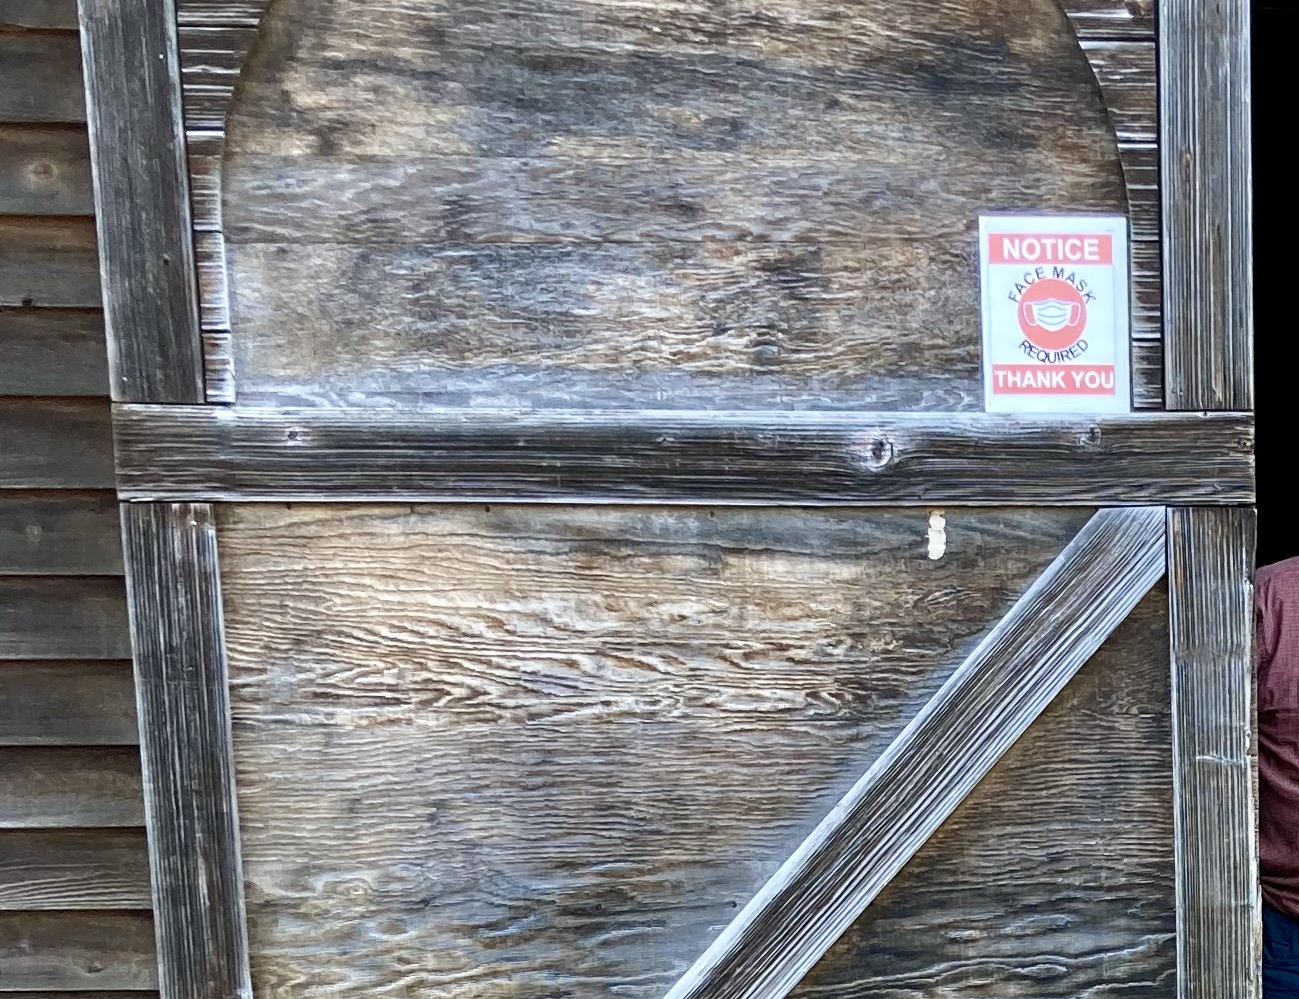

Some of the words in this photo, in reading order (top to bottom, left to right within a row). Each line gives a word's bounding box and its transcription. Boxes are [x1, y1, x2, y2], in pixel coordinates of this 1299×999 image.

[1002, 237, 1100, 260] NOTICE
[1008, 266, 1045, 303] FACE
[1052, 266, 1096, 304] MASK
[1018, 338, 1089, 364] REQUIRED
[994, 371, 1066, 389] THANK
[1071, 371, 1114, 389] YOU
